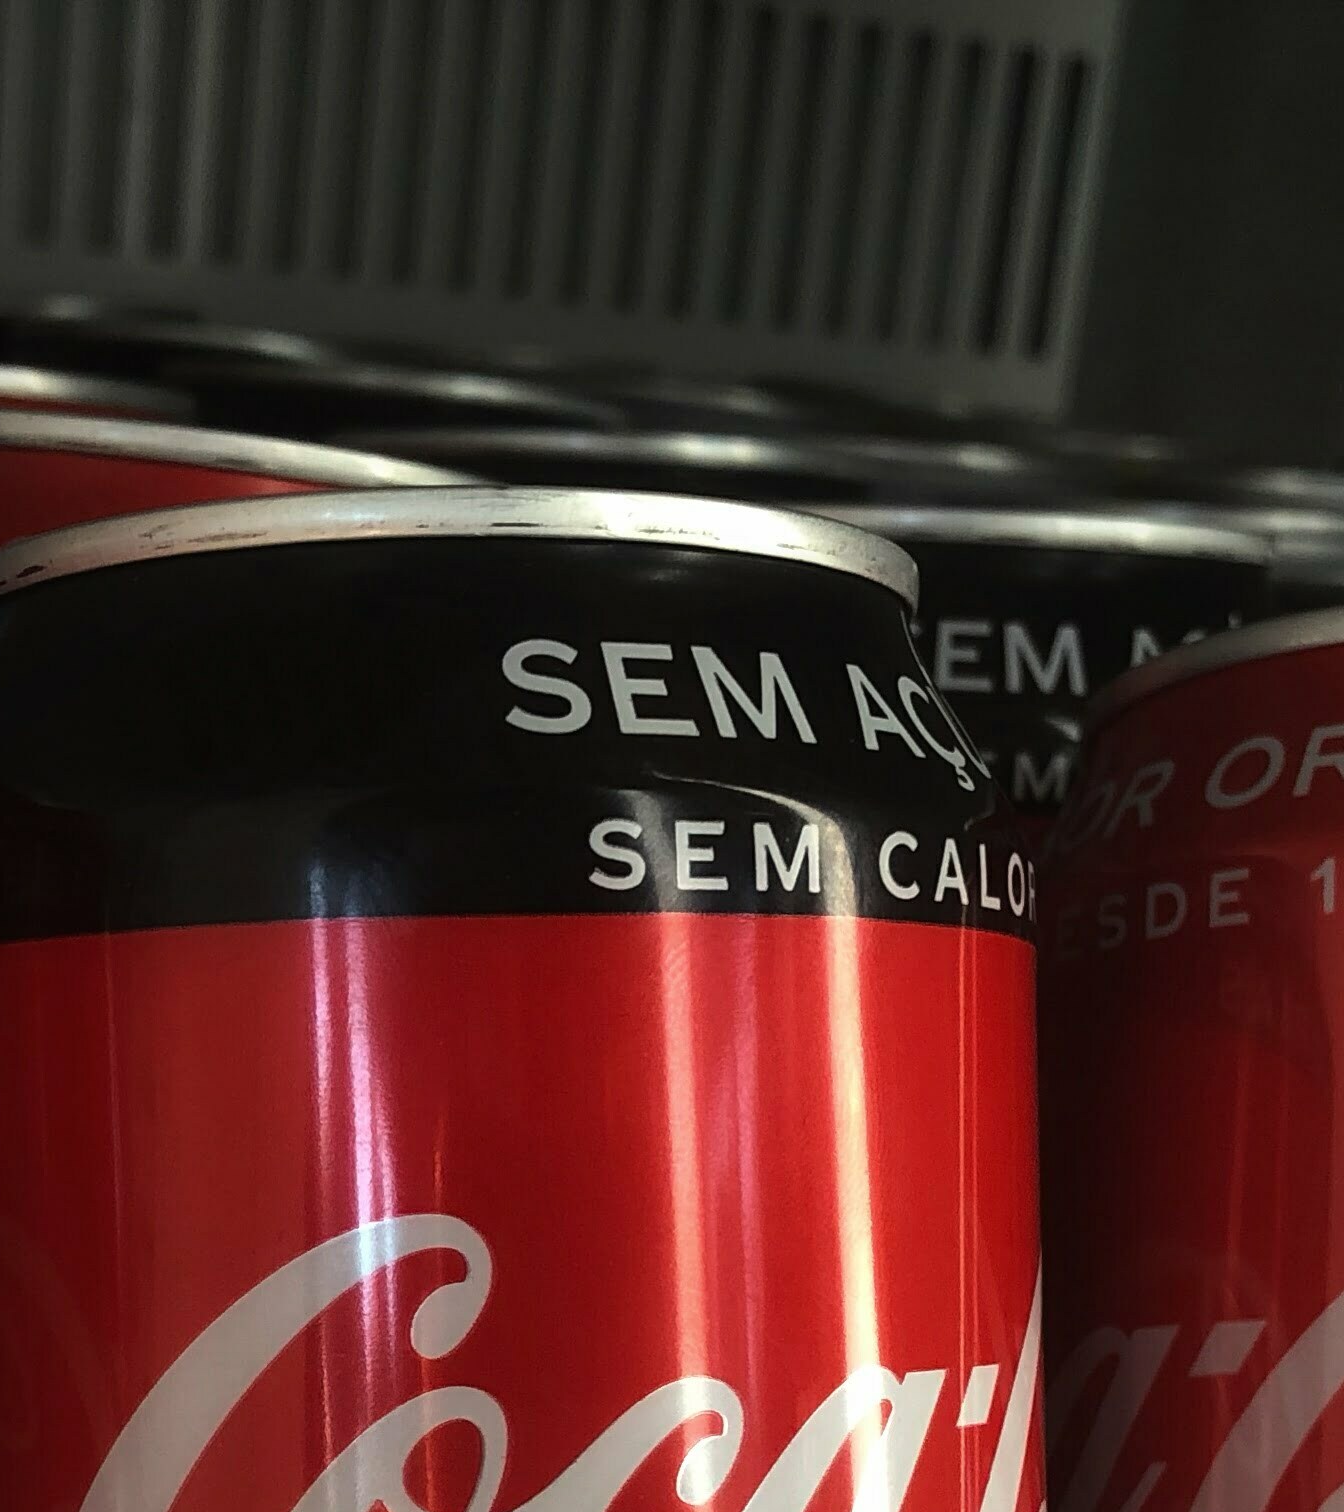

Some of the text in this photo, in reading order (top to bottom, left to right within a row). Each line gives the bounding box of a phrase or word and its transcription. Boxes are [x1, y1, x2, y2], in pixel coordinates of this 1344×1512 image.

[502, 638, 818, 743] SEM
[910, 617, 1088, 698] EM
[588, 817, 821, 894] SEM
